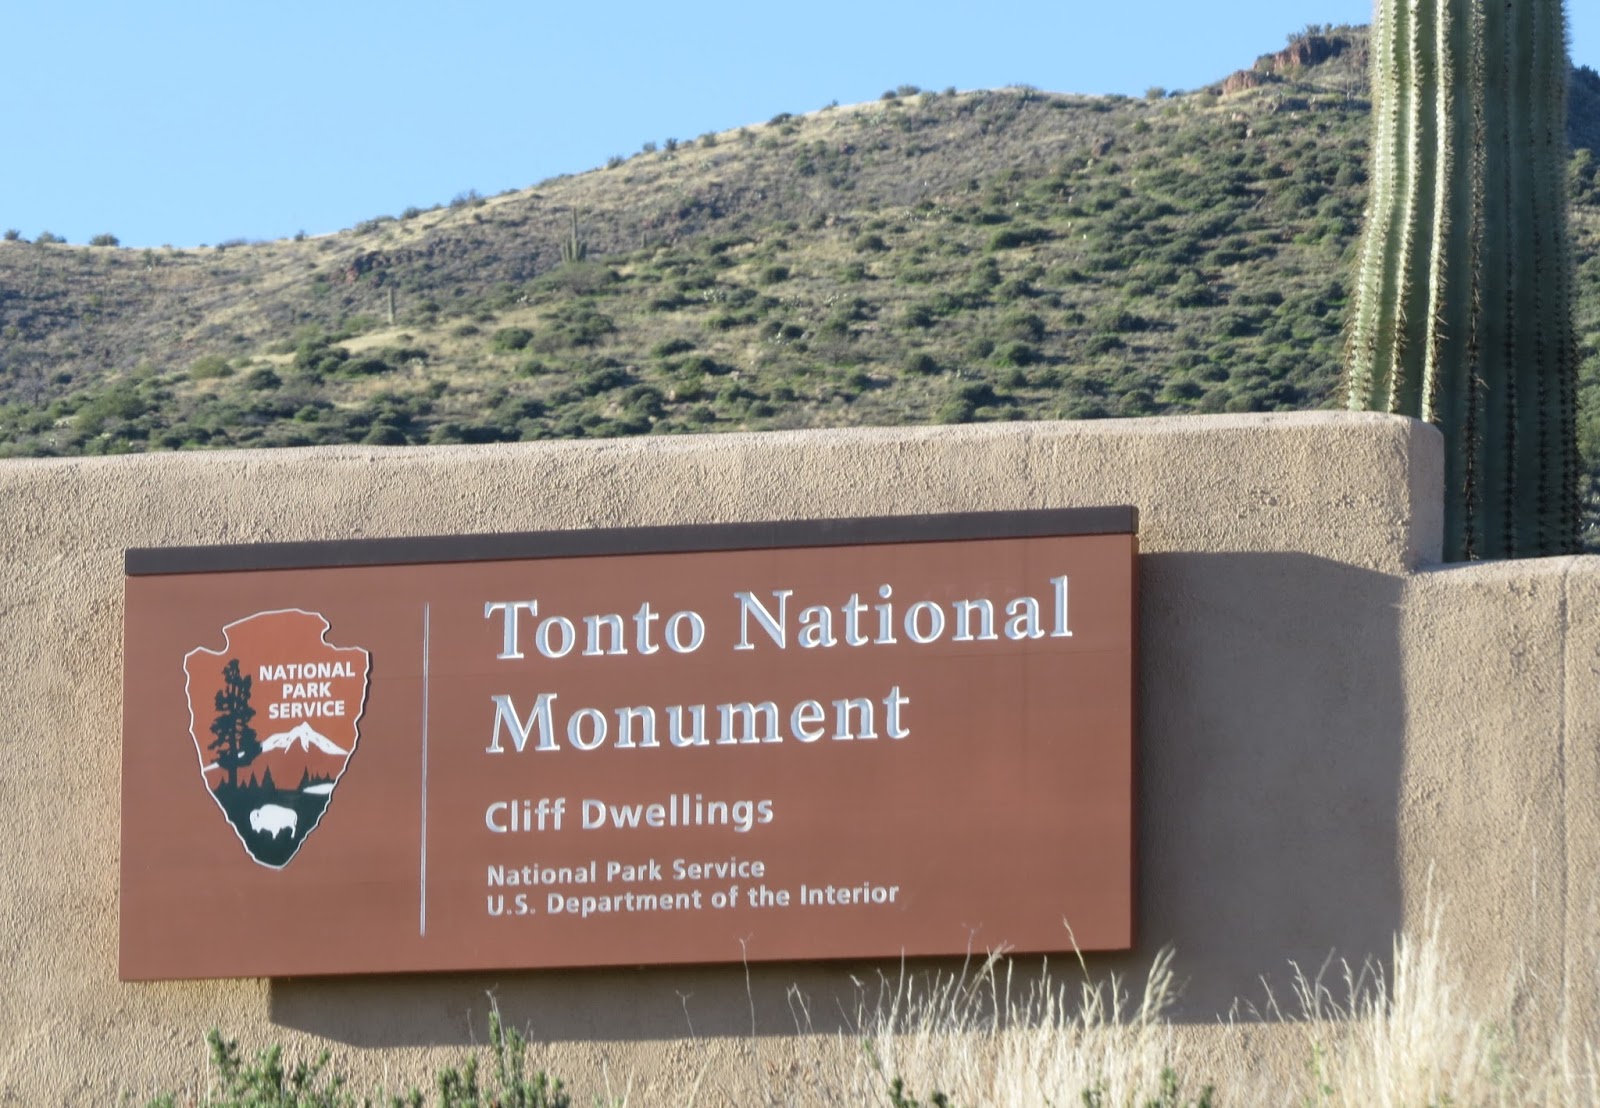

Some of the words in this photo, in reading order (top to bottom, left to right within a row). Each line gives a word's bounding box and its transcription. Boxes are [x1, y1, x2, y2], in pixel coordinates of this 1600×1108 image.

[484, 599, 706, 661] Tonto
[733, 575, 1074, 651] National
[259, 661, 356, 682] NATIONAL
[282, 682, 332, 699] PARK
[268, 700, 346, 720] SERVICE
[486, 685, 911, 754] Monument
[485, 797, 566, 833] Cliff
[581, 794, 774, 833] Dwellings
[487, 861, 597, 886] National
[606, 859, 663, 882] Park
[672, 857, 766, 880] Service
[487, 893, 536, 916] U.S.
[547, 889, 702, 918] Department
[711, 885, 739, 908] of
[747, 883, 791, 907] the
[800, 882, 900, 905] Interior
